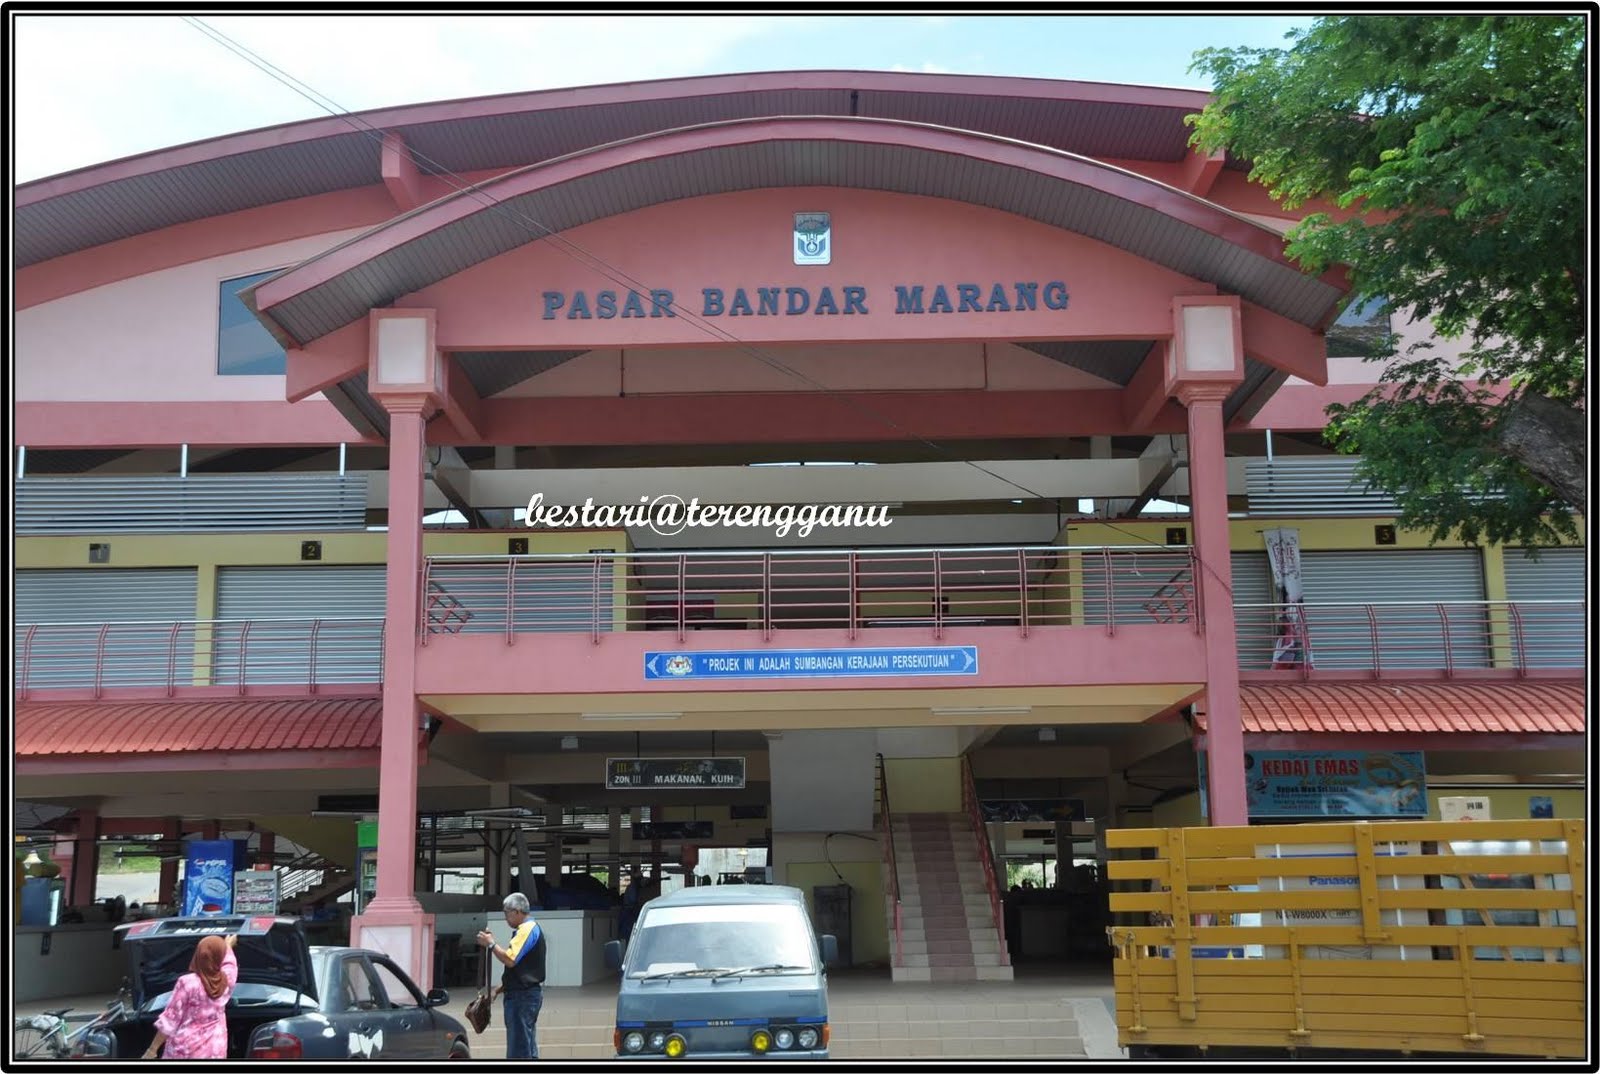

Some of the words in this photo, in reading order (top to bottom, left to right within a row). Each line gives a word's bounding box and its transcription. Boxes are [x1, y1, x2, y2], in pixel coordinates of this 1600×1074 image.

[542, 290, 676, 320] PASAR
[702, 286, 869, 317] BANDAR
[894, 281, 1070, 315] MARANG
[744, 658, 755, 671] INI
[759, 657, 790, 671] ADALAH
[794, 655, 843, 670] SUMBANGAN
[847, 654, 889, 669] KERAJAAN
[1262, 760, 1310, 777] KEDAI
[1315, 759, 1359, 776] EMAS
[614, 775, 630, 784] ZON
[711, 774, 734, 784] KUIH
